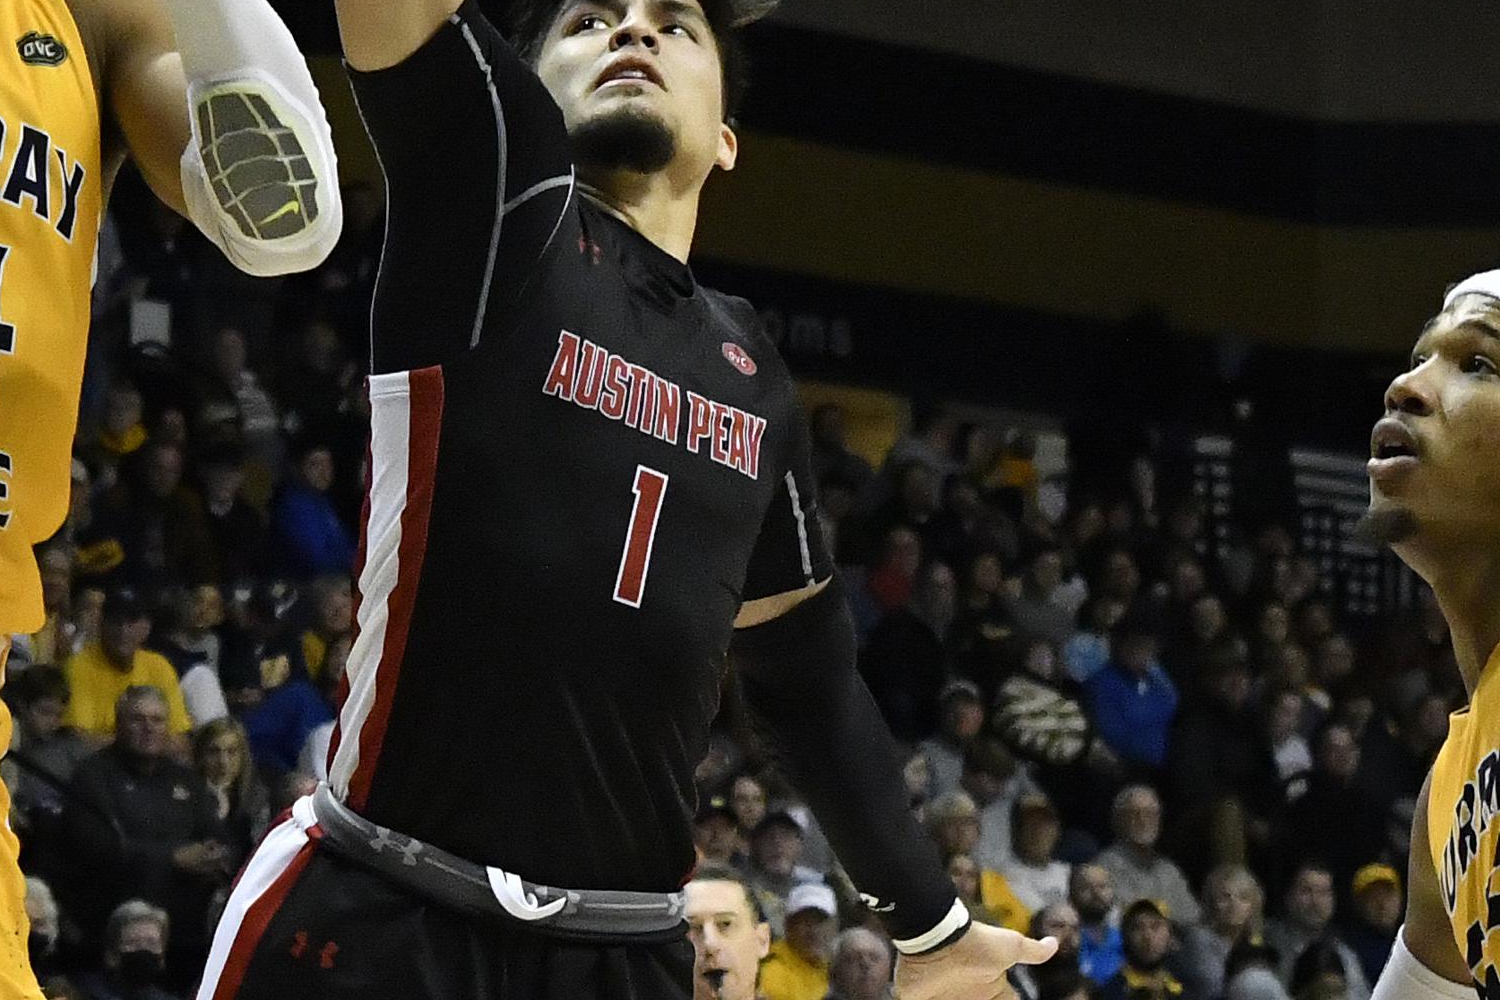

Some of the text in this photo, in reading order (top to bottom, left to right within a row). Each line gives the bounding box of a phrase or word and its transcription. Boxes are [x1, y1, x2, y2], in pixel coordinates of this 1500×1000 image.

[23, 40, 56, 57] OVC
[542, 329, 767, 480] AUSTIN PEAY
[613, 464, 669, 609] 1
